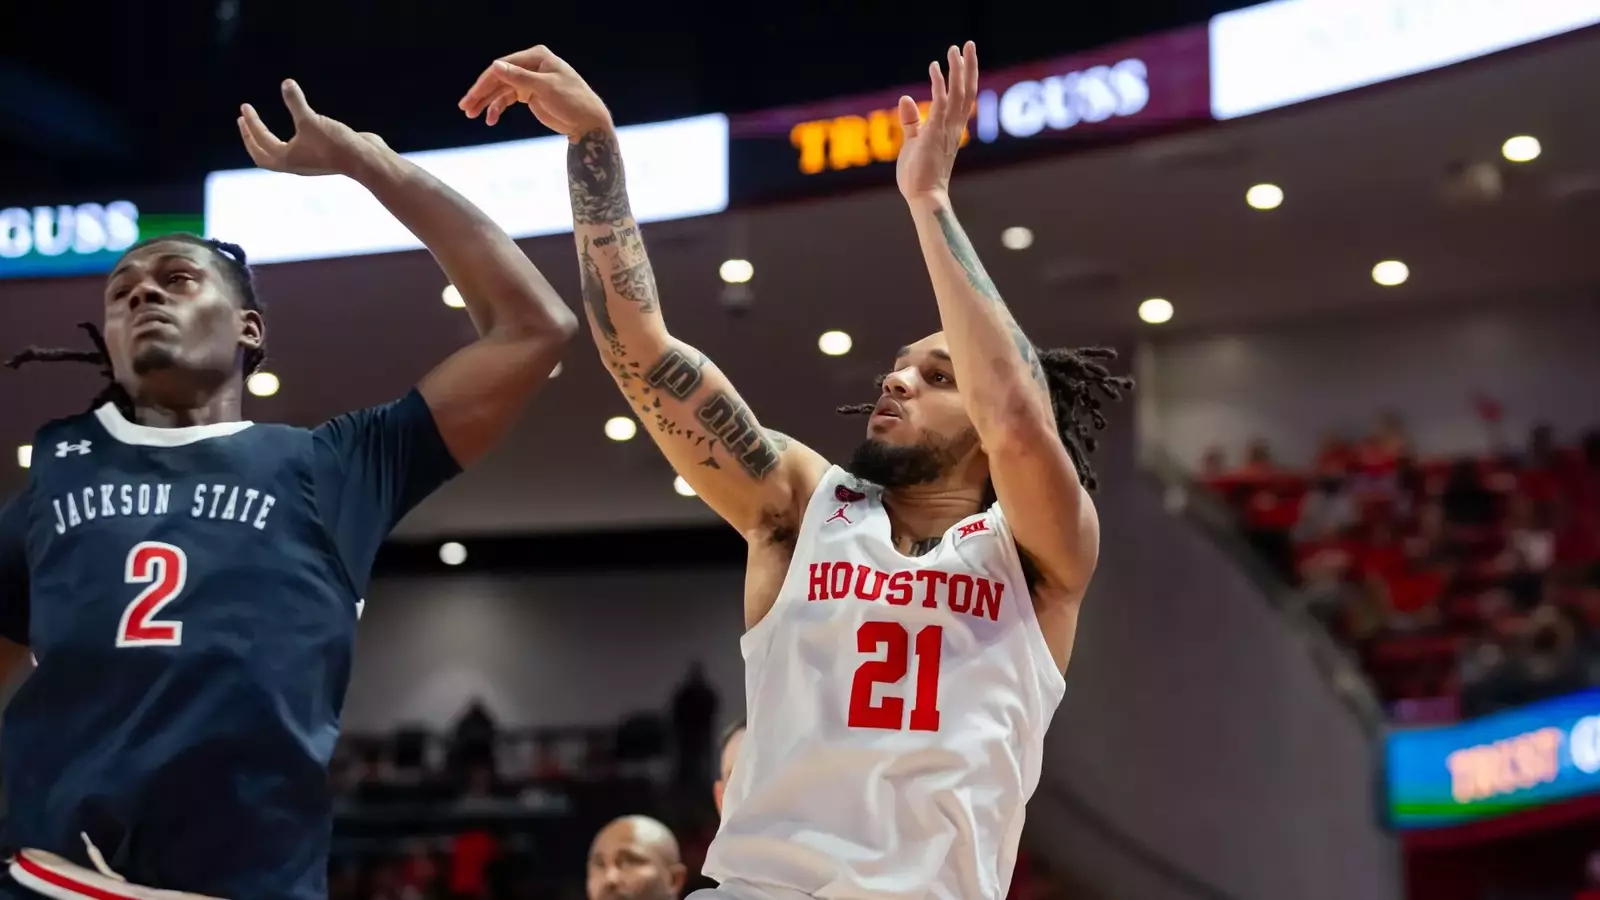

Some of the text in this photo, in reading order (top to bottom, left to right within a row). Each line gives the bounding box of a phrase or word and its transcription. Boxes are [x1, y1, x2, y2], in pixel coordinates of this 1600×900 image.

[790, 58, 1149, 174] TRU GUSS
[0, 200, 139, 258] GUSS
[53, 484, 276, 534] JACKSON STATE
[115, 541, 187, 648] 2
[807, 561, 1005, 621] HOUSTON
[848, 621, 943, 732] 21
